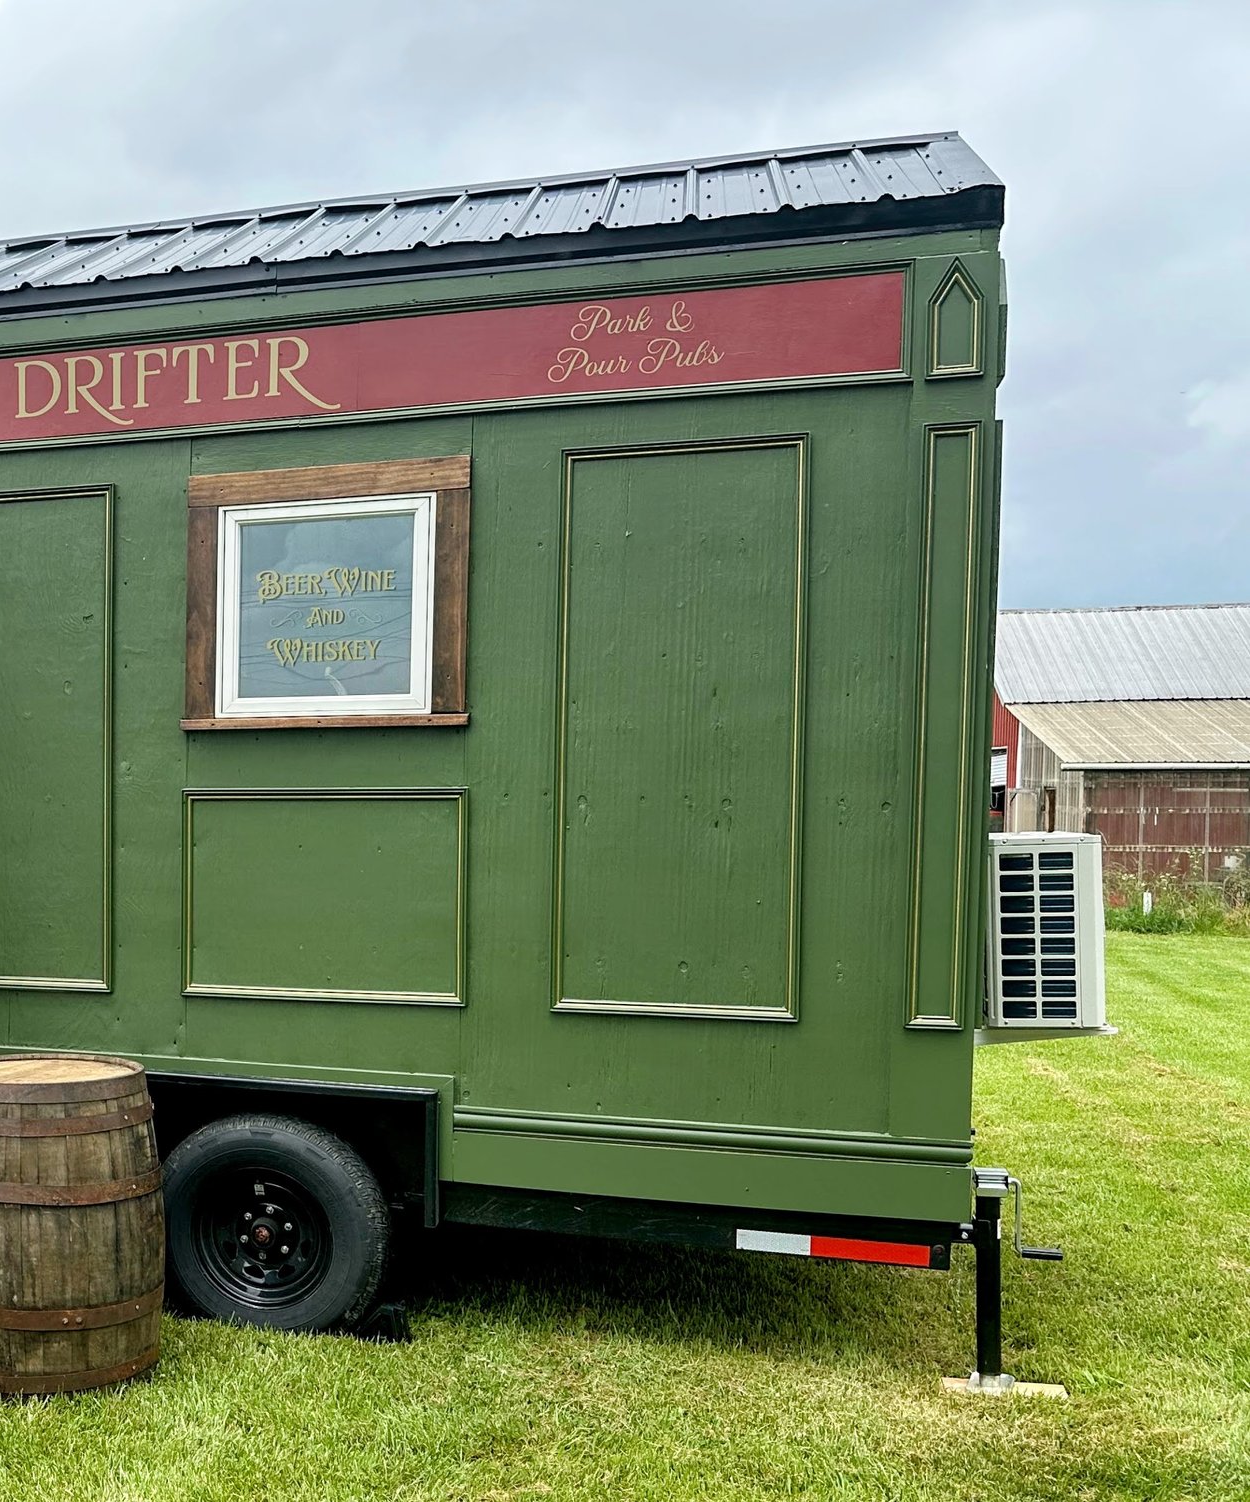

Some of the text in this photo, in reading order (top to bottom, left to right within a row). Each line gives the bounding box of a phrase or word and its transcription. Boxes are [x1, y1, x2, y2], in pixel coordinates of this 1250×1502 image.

[570, 300, 695, 342] Park &
[13, 336, 341, 425] DRIFTER
[547, 338, 725, 383] Pour Pubs
